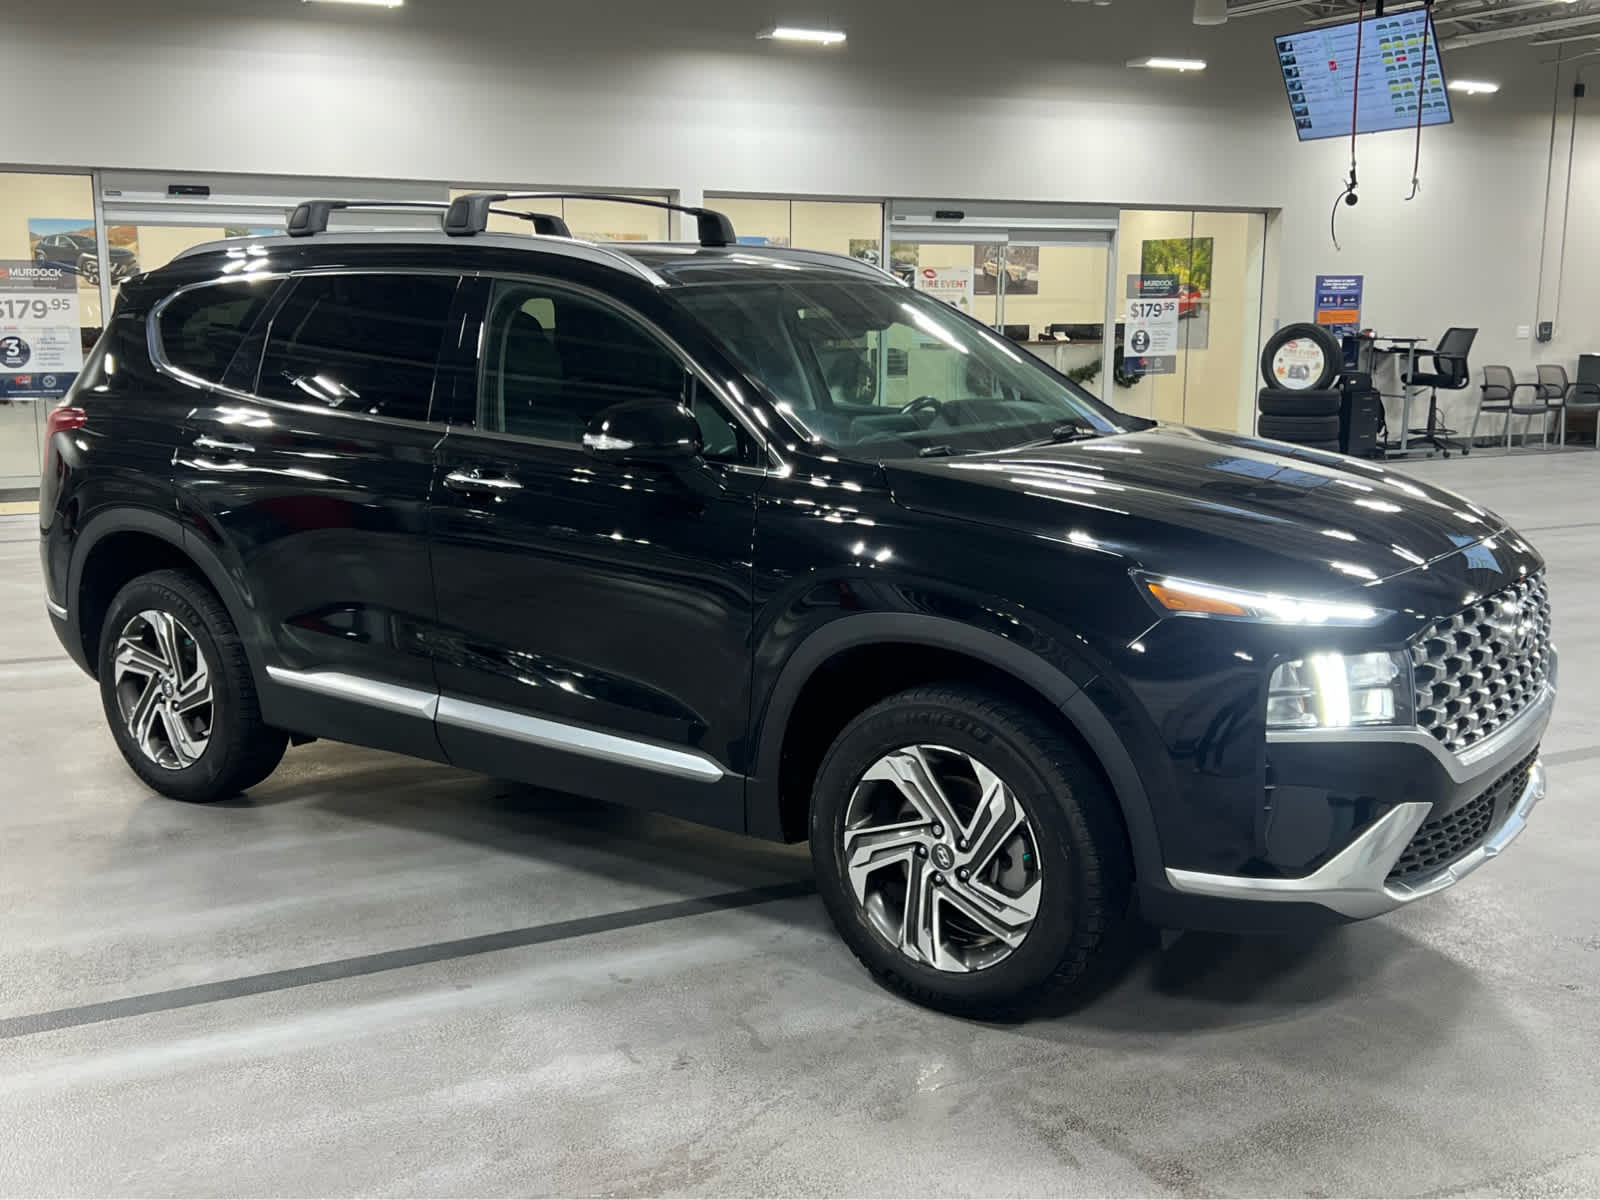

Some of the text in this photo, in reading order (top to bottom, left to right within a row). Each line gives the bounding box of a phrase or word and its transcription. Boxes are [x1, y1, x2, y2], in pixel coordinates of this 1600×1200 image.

[8, 268, 62, 277] MURDOCK
[921, 279, 968, 288] TIRE EVENT
[1136, 332, 1144, 344] 3
[6, 339, 20, 356] 3
